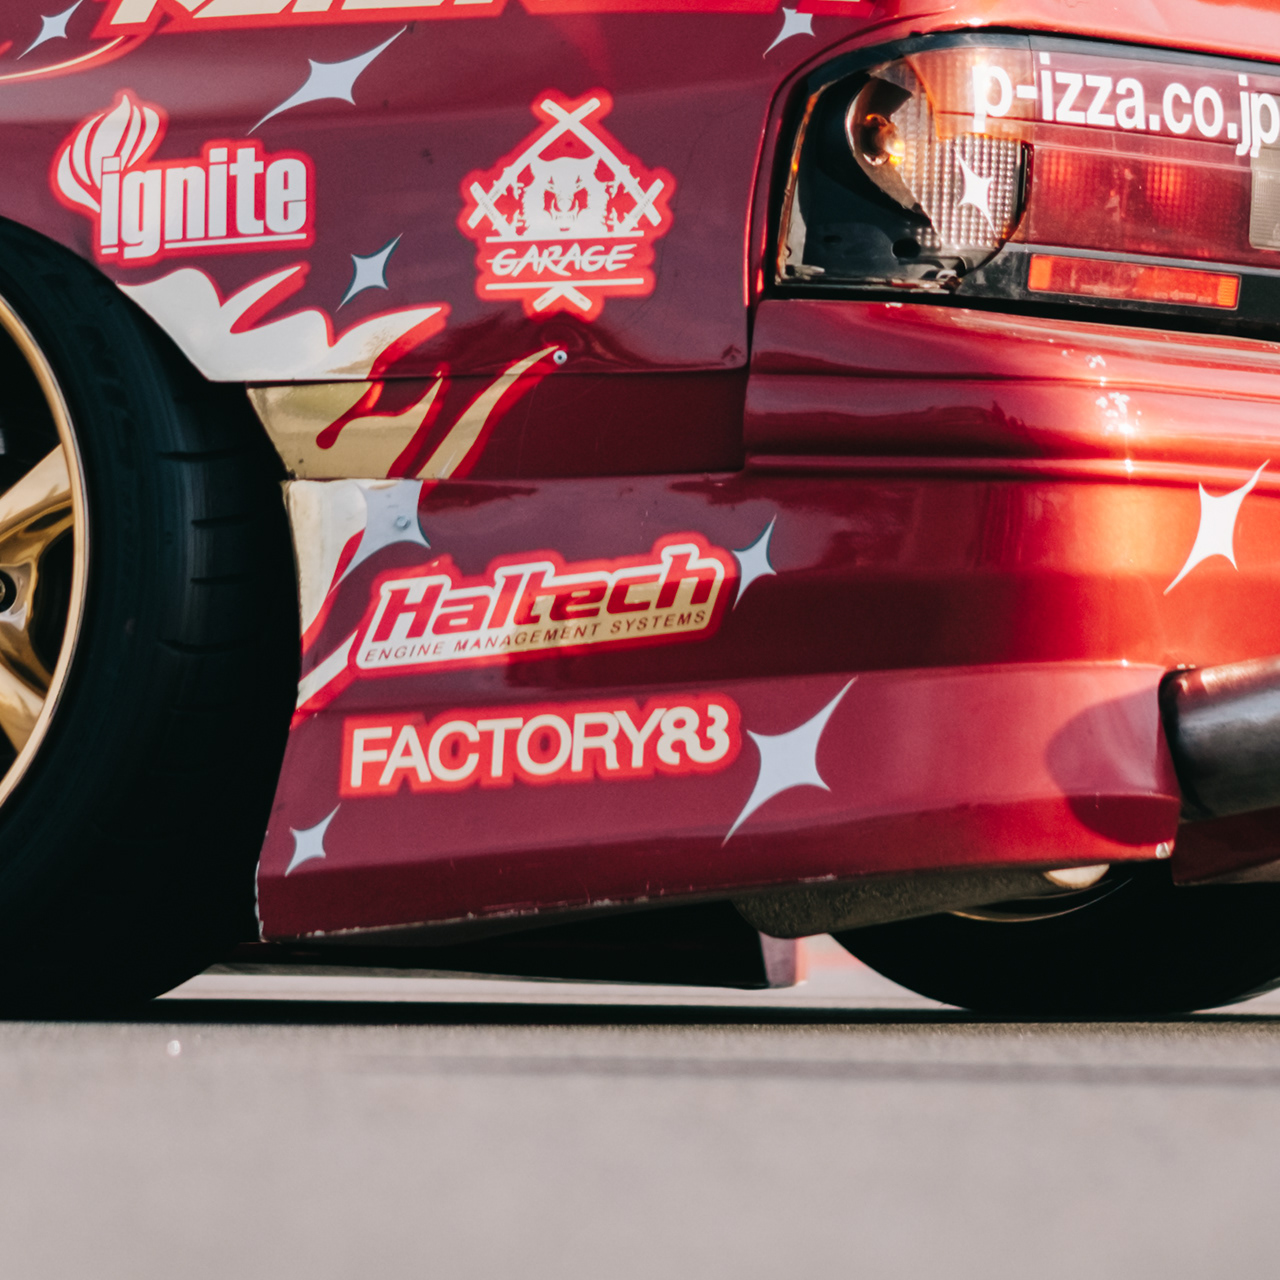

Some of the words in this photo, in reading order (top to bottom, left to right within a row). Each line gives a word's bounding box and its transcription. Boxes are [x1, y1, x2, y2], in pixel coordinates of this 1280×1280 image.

[971, 52, 1280, 157] p-izza.co.jp
[99, 147, 308, 259] ignite
[486, 242, 638, 278] GARAGE
[363, 640, 445, 663] ENGINE
[453, 622, 602, 654] MANAGEMENT
[610, 609, 707, 635] SYSTEMS
[370, 553, 721, 643] Haltech
[350, 703, 730, 788] FACTORY83
